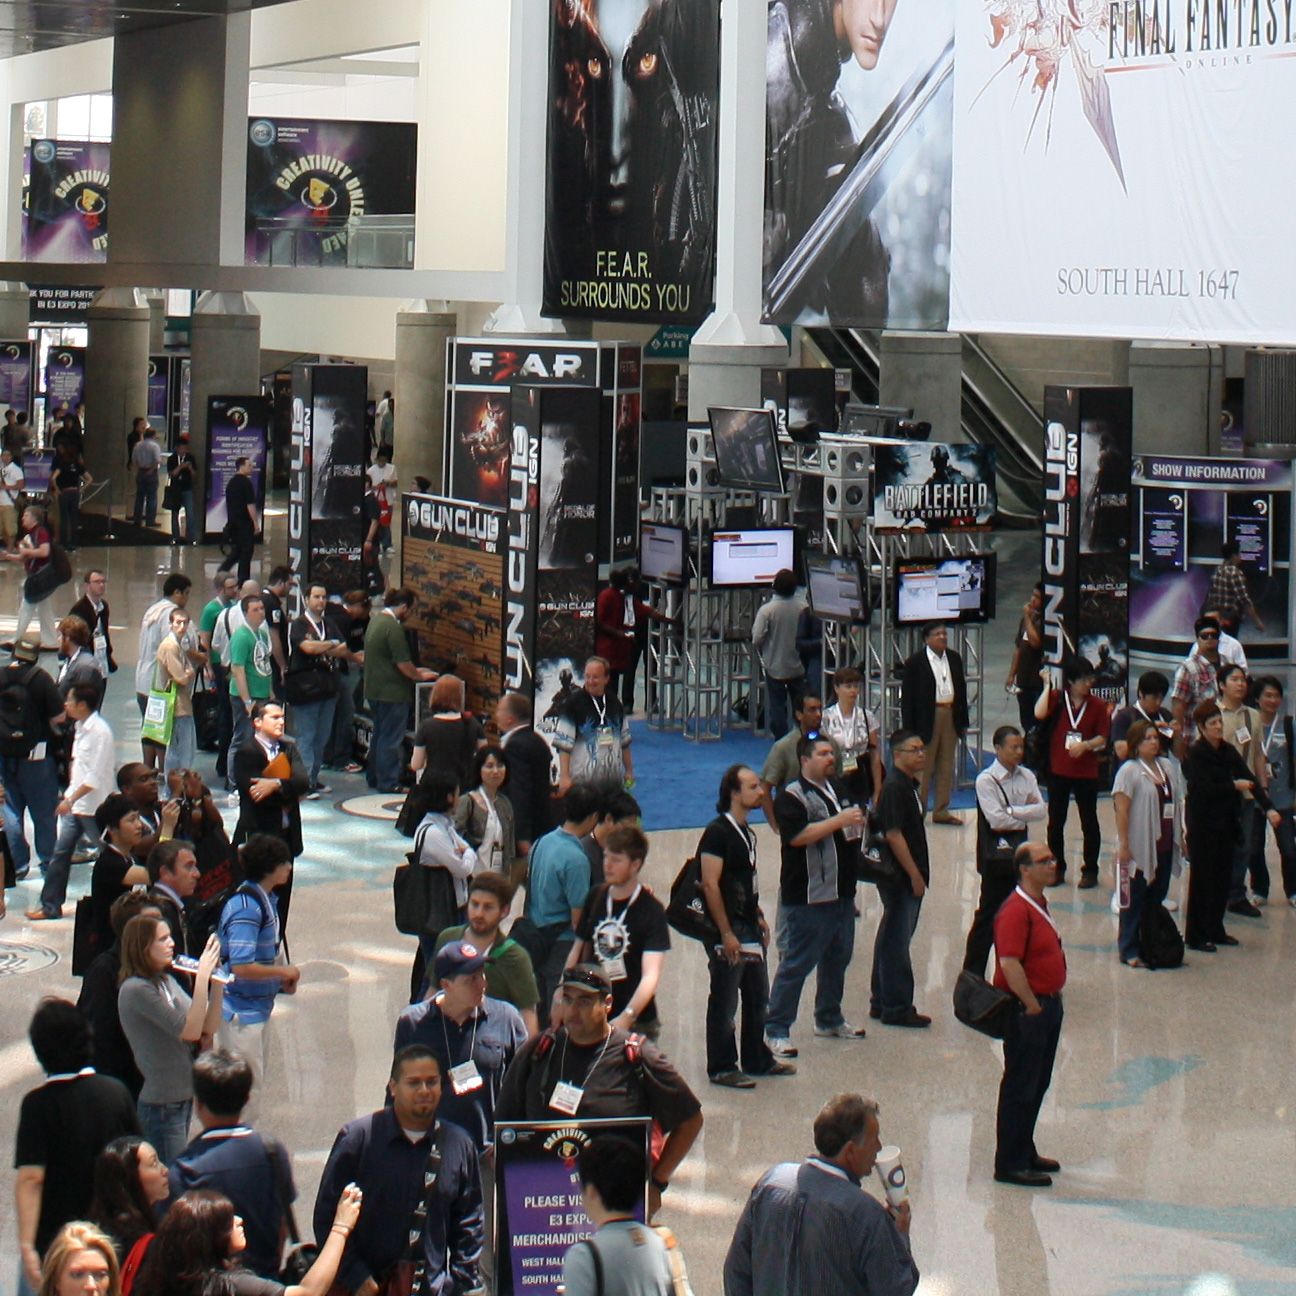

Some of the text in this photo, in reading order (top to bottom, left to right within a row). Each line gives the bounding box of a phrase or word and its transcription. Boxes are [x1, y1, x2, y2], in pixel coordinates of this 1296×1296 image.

[1186, 55, 1254, 69] ONLINE
[276, 154, 352, 190] CREATIVITY
[595, 251, 652, 279] F.E.A.R.
[561, 281, 691, 313] SURROUNDS YOU
[1057, 268, 1240, 300] SOUTH HALL 1647
[529, 438, 538, 484] IGN
[1067, 433, 1077, 476] IGN
[1152, 463, 1266, 480] SHOW INFORMATION
[508, 425, 530, 592] CLUB
[885, 483, 988, 510] BATTLEFIELD
[1045, 423, 1066, 576] CLUB
[421, 502, 499, 541] GUN CLUB
[544, 1128, 587, 1150] CREATIVITY
[524, 1195, 565, 1208] PLEASE
[549, 1214, 563, 1226] E3
[522, 1257, 544, 1267] WEST
[522, 1274, 548, 1285] SOUTH
